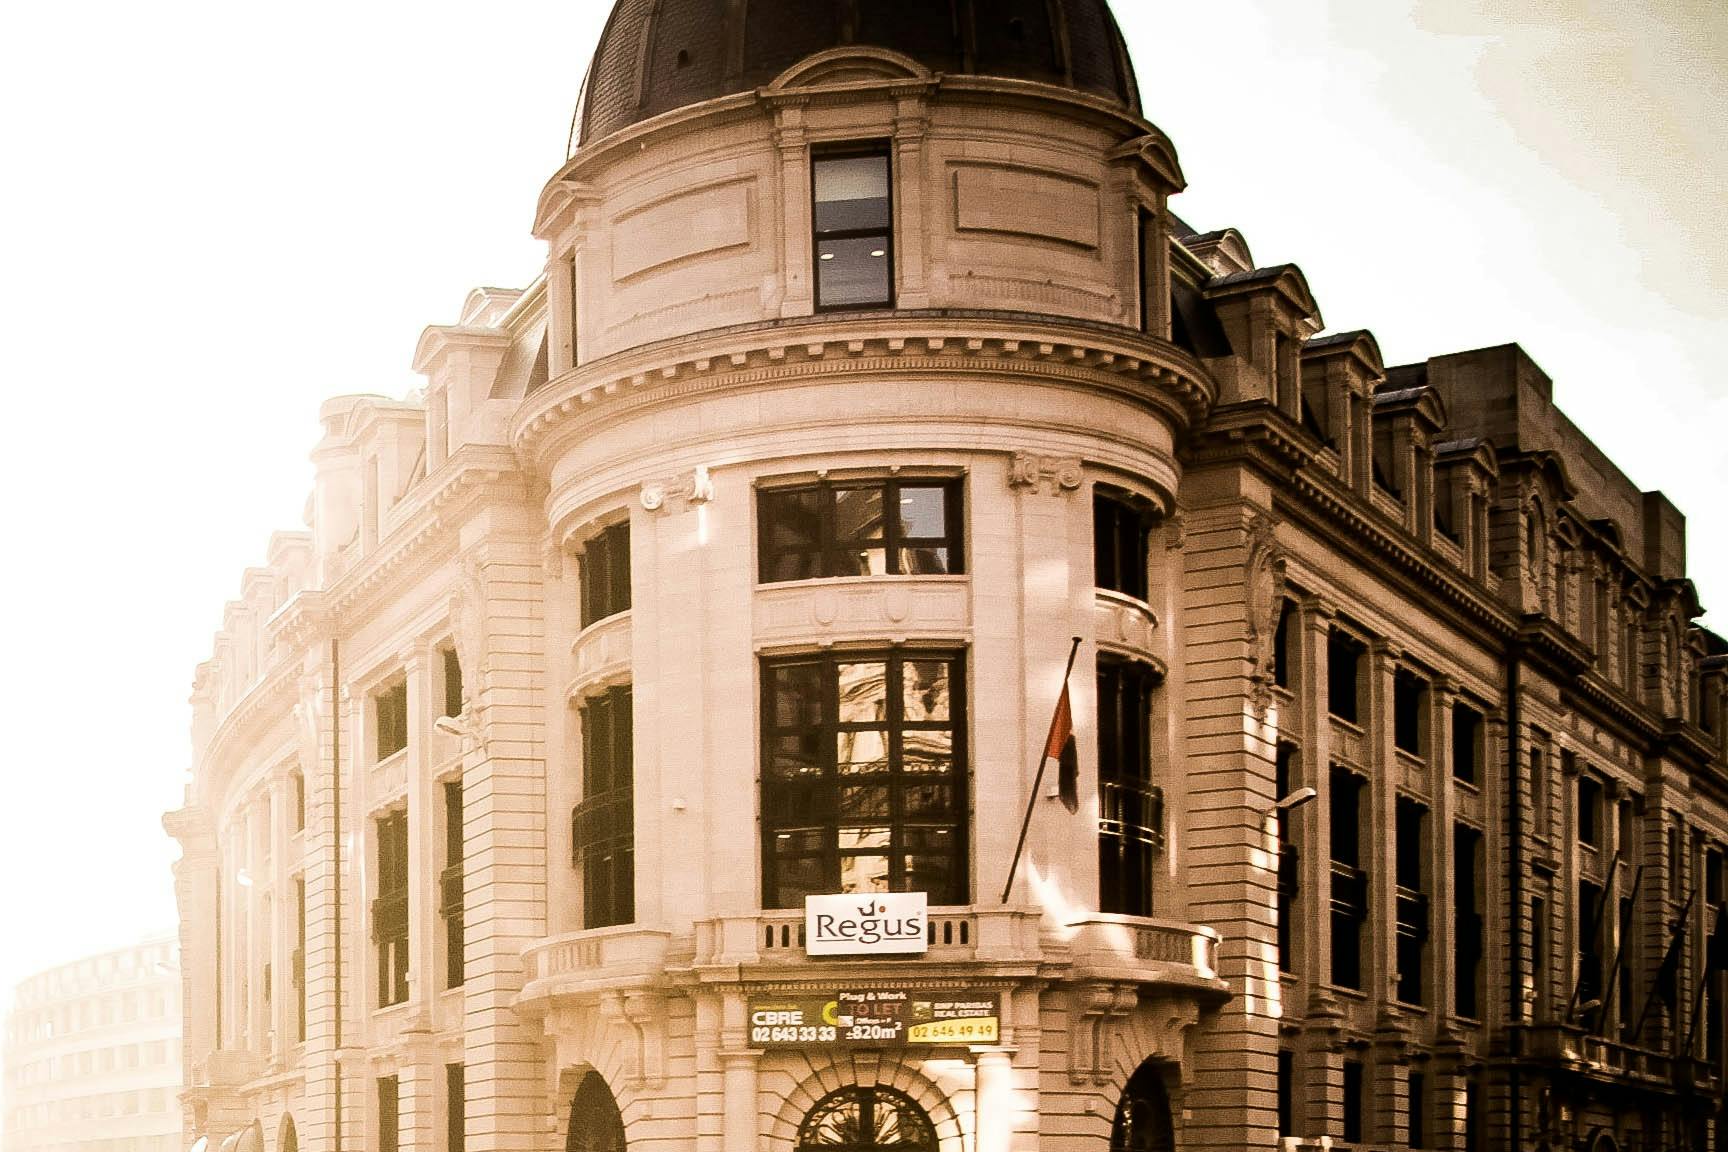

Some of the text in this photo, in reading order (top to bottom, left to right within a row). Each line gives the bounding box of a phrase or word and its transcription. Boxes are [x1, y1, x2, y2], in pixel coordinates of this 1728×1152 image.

[815, 914, 922, 945] Regus
[839, 991, 907, 1002] Plug & Work
[848, 1002, 903, 1016] TO LET
[954, 1001, 993, 1009] PARIBAS
[752, 1011, 804, 1026] CBRE
[752, 1026, 836, 1041] 02 643 33 33
[913, 1027, 928, 1037] 02
[959, 1025, 974, 1035] 49
[978, 1025, 993, 1035] 49
